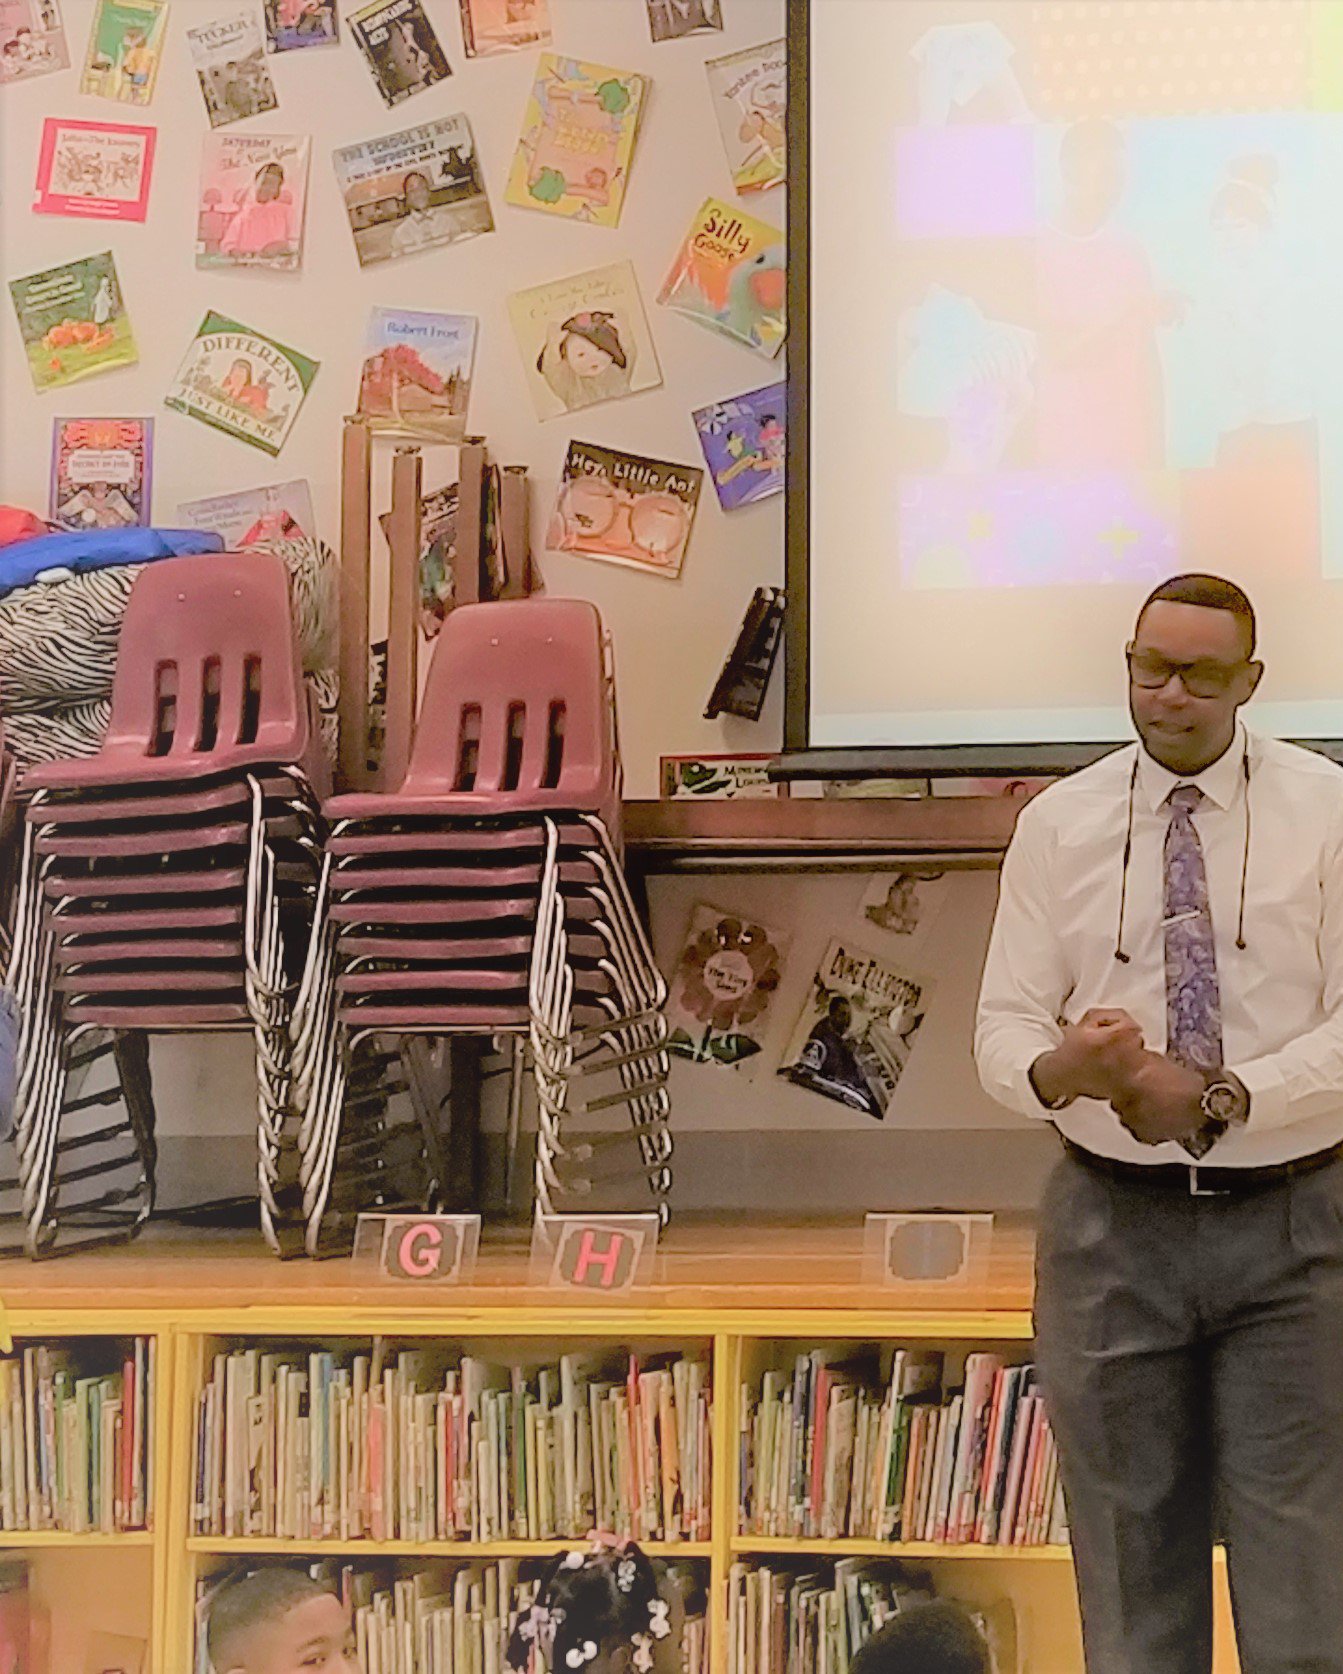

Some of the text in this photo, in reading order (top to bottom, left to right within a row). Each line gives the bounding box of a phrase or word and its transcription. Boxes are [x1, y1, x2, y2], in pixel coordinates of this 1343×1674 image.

[704, 208, 751, 254] Silly
[387, 322, 428, 336] Robert
[202, 336, 299, 393] DIFFERENT
[179, 388, 213, 410] JUST
[217, 404, 250, 427] LIKE
[614, 462, 659, 486] Little
[664, 474, 696, 494] Ant
[400, 1223, 442, 1276] G
[572, 1229, 624, 1287] H
